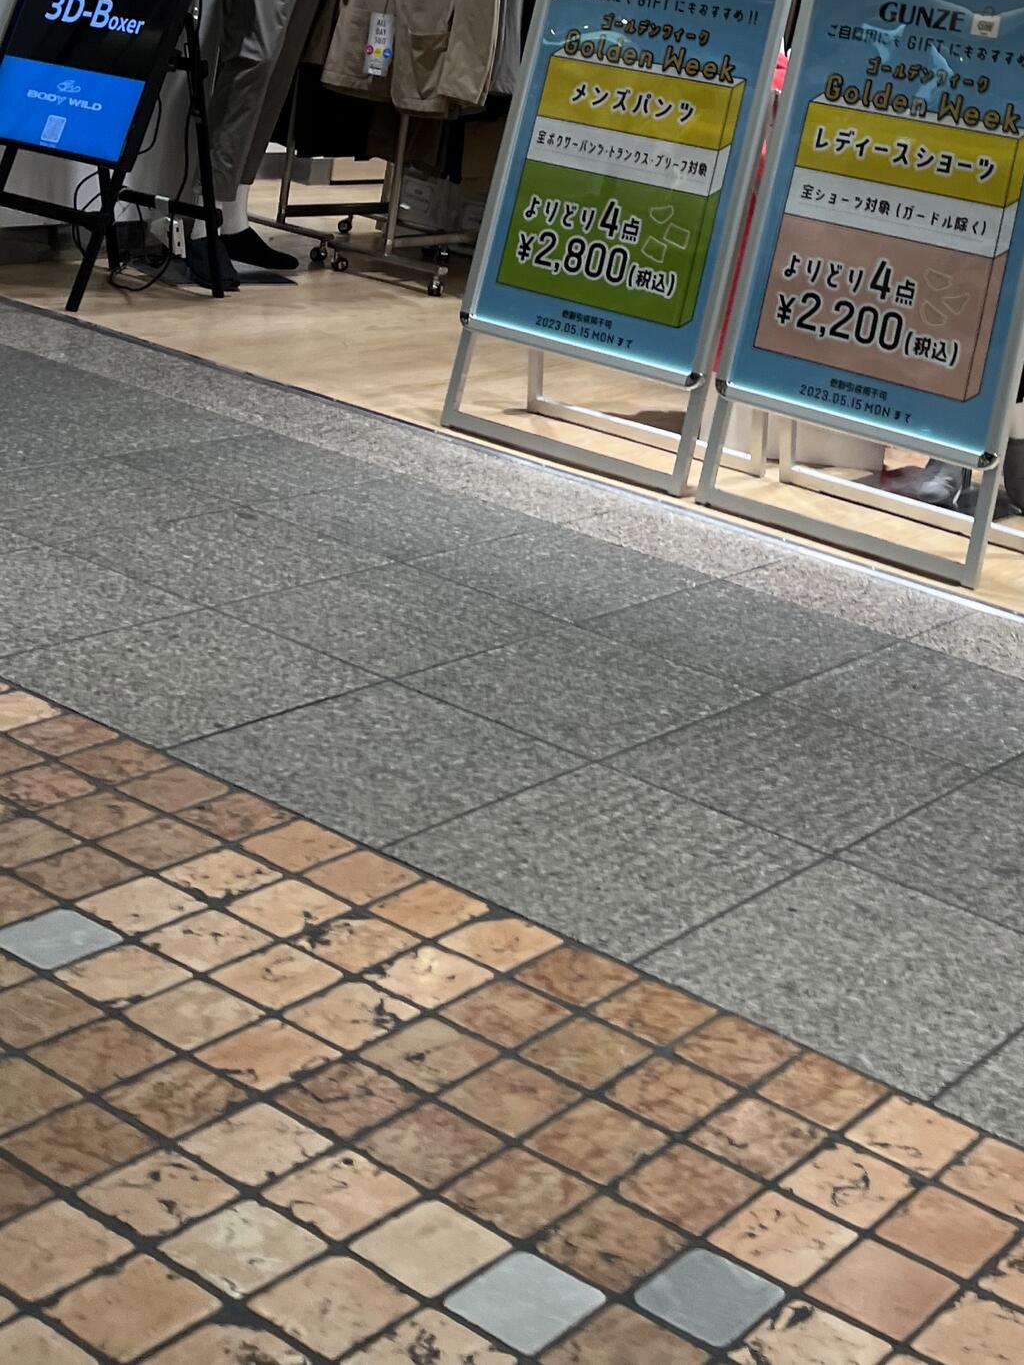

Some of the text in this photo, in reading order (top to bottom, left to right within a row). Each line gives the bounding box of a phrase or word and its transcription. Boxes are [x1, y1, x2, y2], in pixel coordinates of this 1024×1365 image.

[879, 1, 966, 32] GUNZE
[563, 28, 736, 84] Golden Week
[907, 34, 945, 53] GIFT
[27, 89, 103, 111] BODY WILD
[572, 84, 694, 123] メンズパンツ
[824, 72, 1022, 136] Golden Week
[815, 127, 995, 180] レディースショーツ
[525, 196, 640, 242] よりどり4点
[784, 255, 916, 306] よりどり4点
[536, 315, 589, 339] 2023.05.15
[592, 329, 615, 345] MON
[799, 384, 862, 410] 2023.05.15
[864, 401, 891, 417] MON
